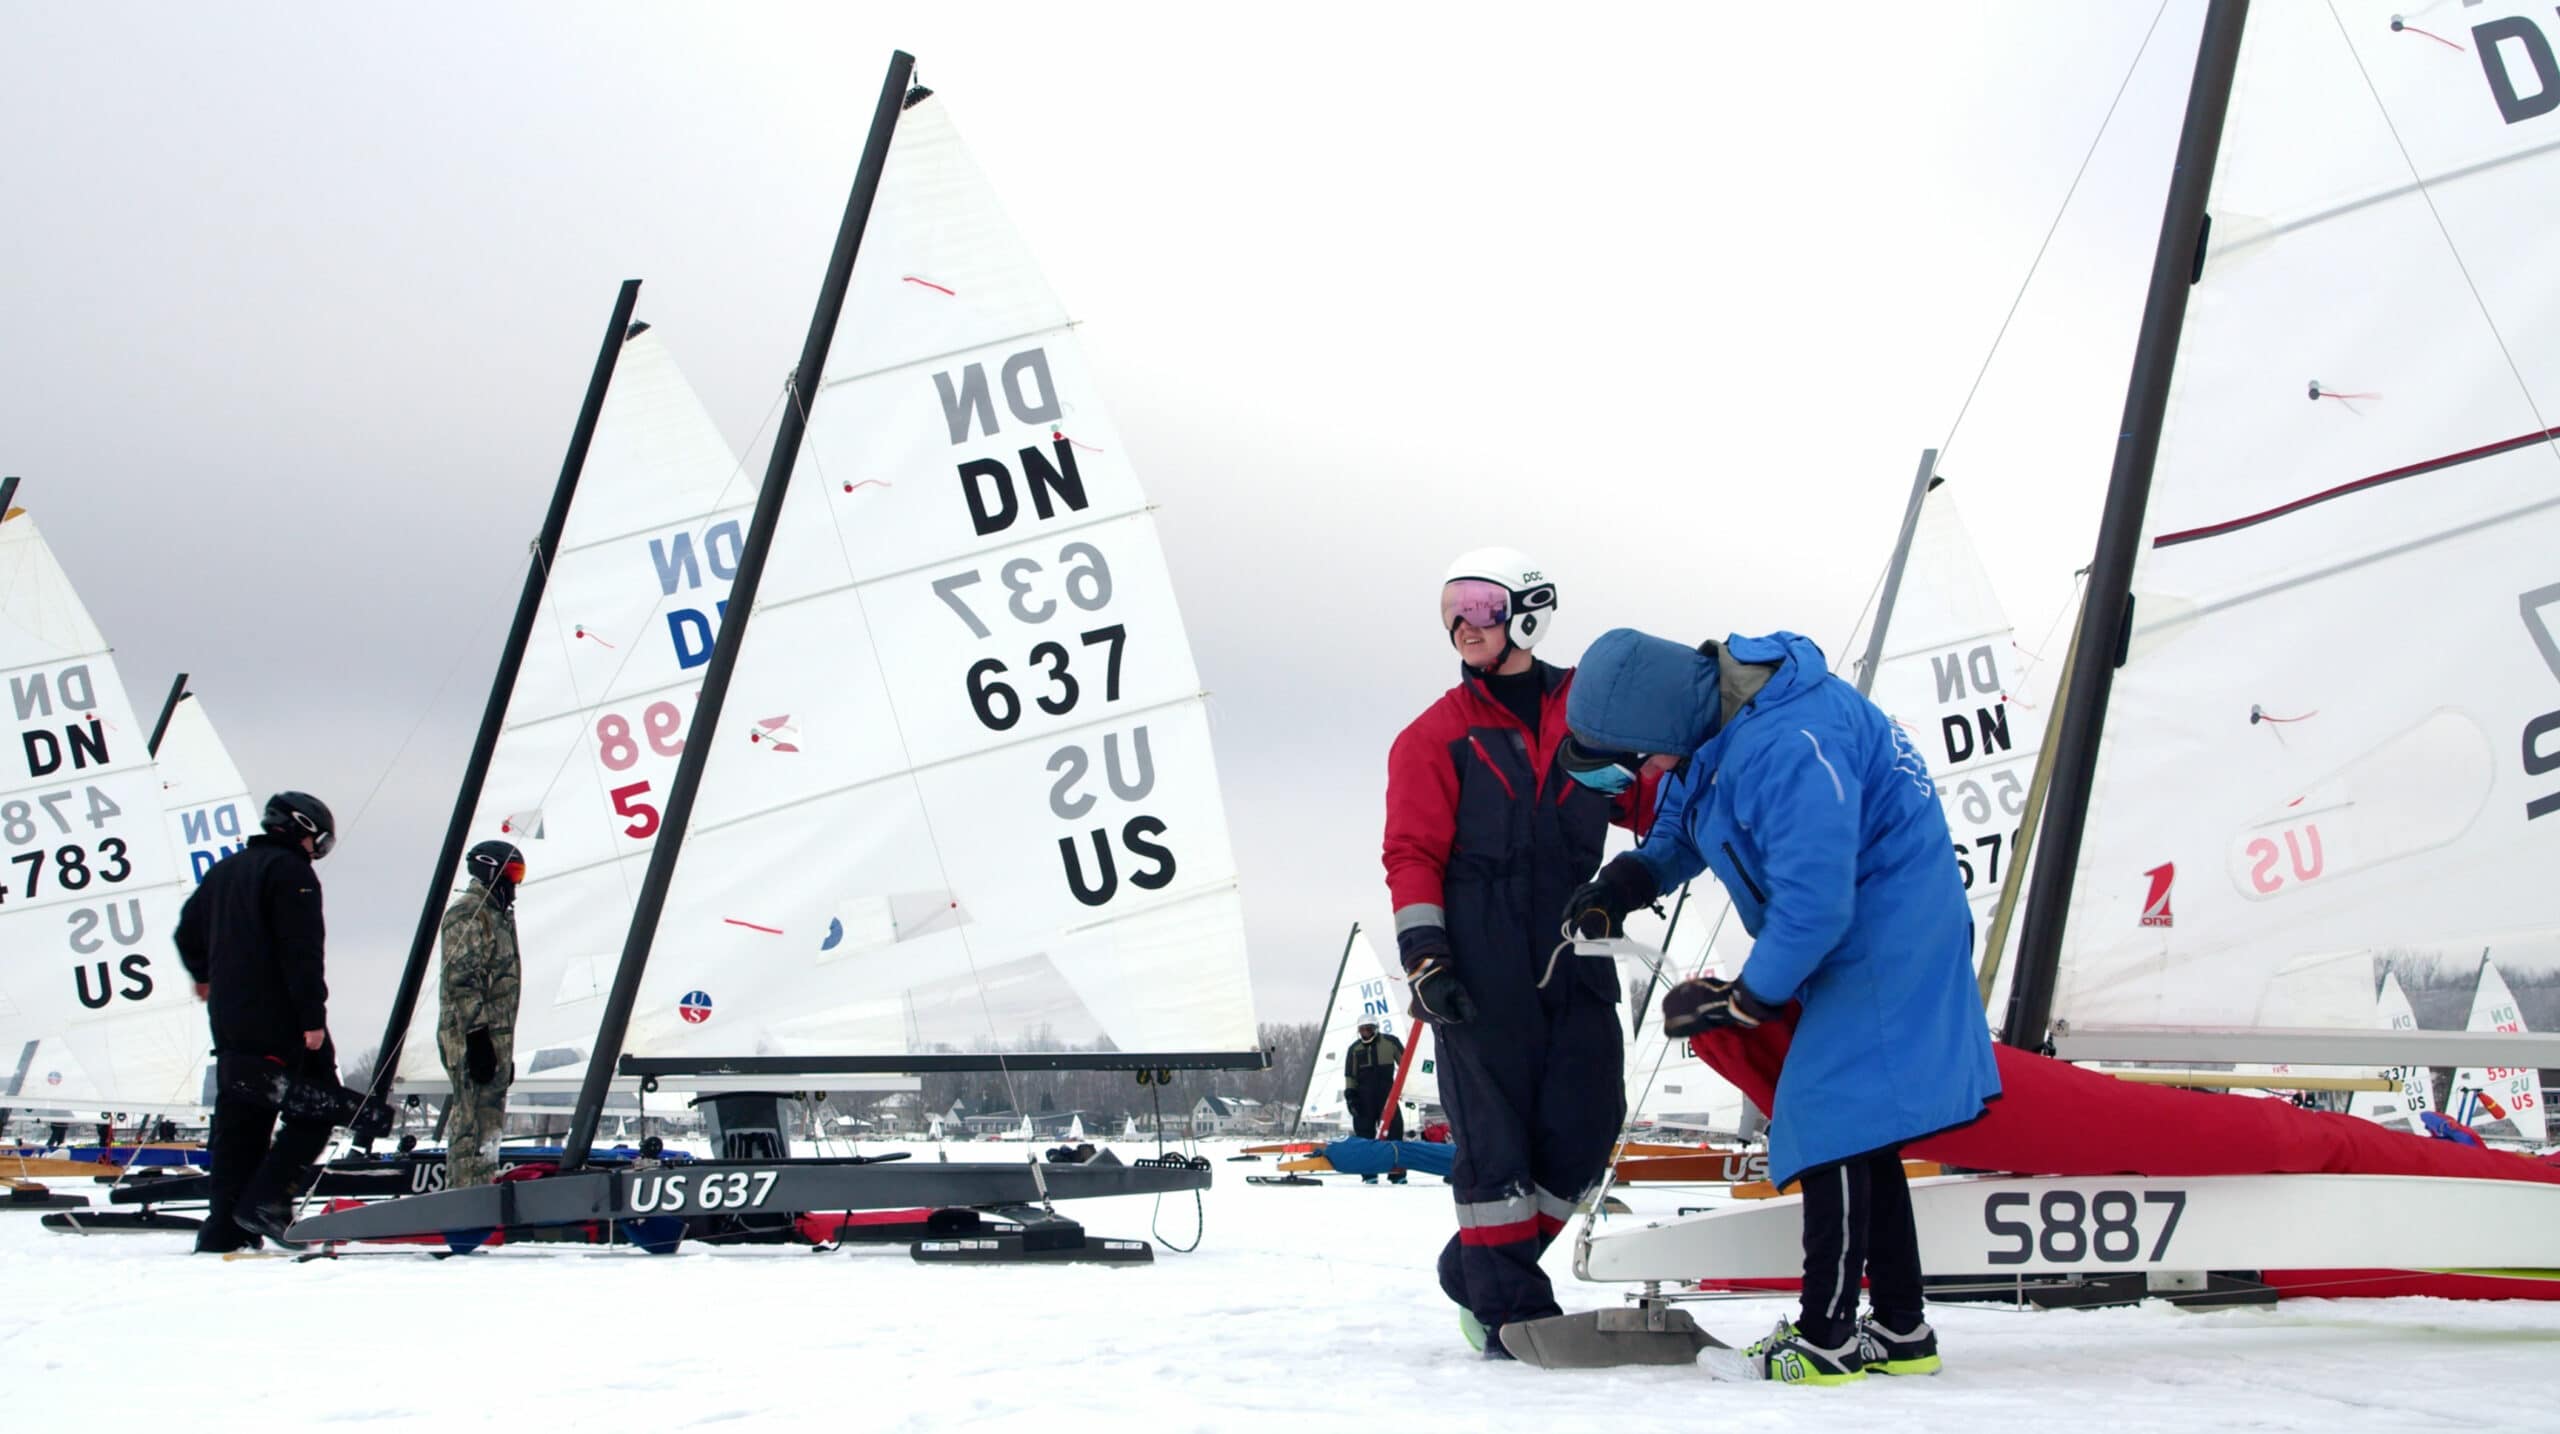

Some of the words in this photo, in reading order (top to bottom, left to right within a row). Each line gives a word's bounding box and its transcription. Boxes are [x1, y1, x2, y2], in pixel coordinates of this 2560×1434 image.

[2471, 6, 2560, 125] D
[957, 438, 1089, 536] DN
[667, 600, 729, 670] D
[966, 624, 1127, 731] 637
[22, 719, 110, 778] DN
[1942, 704, 2012, 764] DN
[1058, 815, 1176, 906] US
[1953, 829, 2018, 890] 67
[74, 954, 153, 1009] US
[2408, 1096, 2425, 1111] US
[2511, 1093, 2534, 1110] US
[412, 1162, 446, 1192] US
[630, 1175, 687, 1213] US
[699, 1171, 778, 1210] 637
[1723, 1156, 1769, 1180] US
[1985, 1190, 2186, 1265] S887
